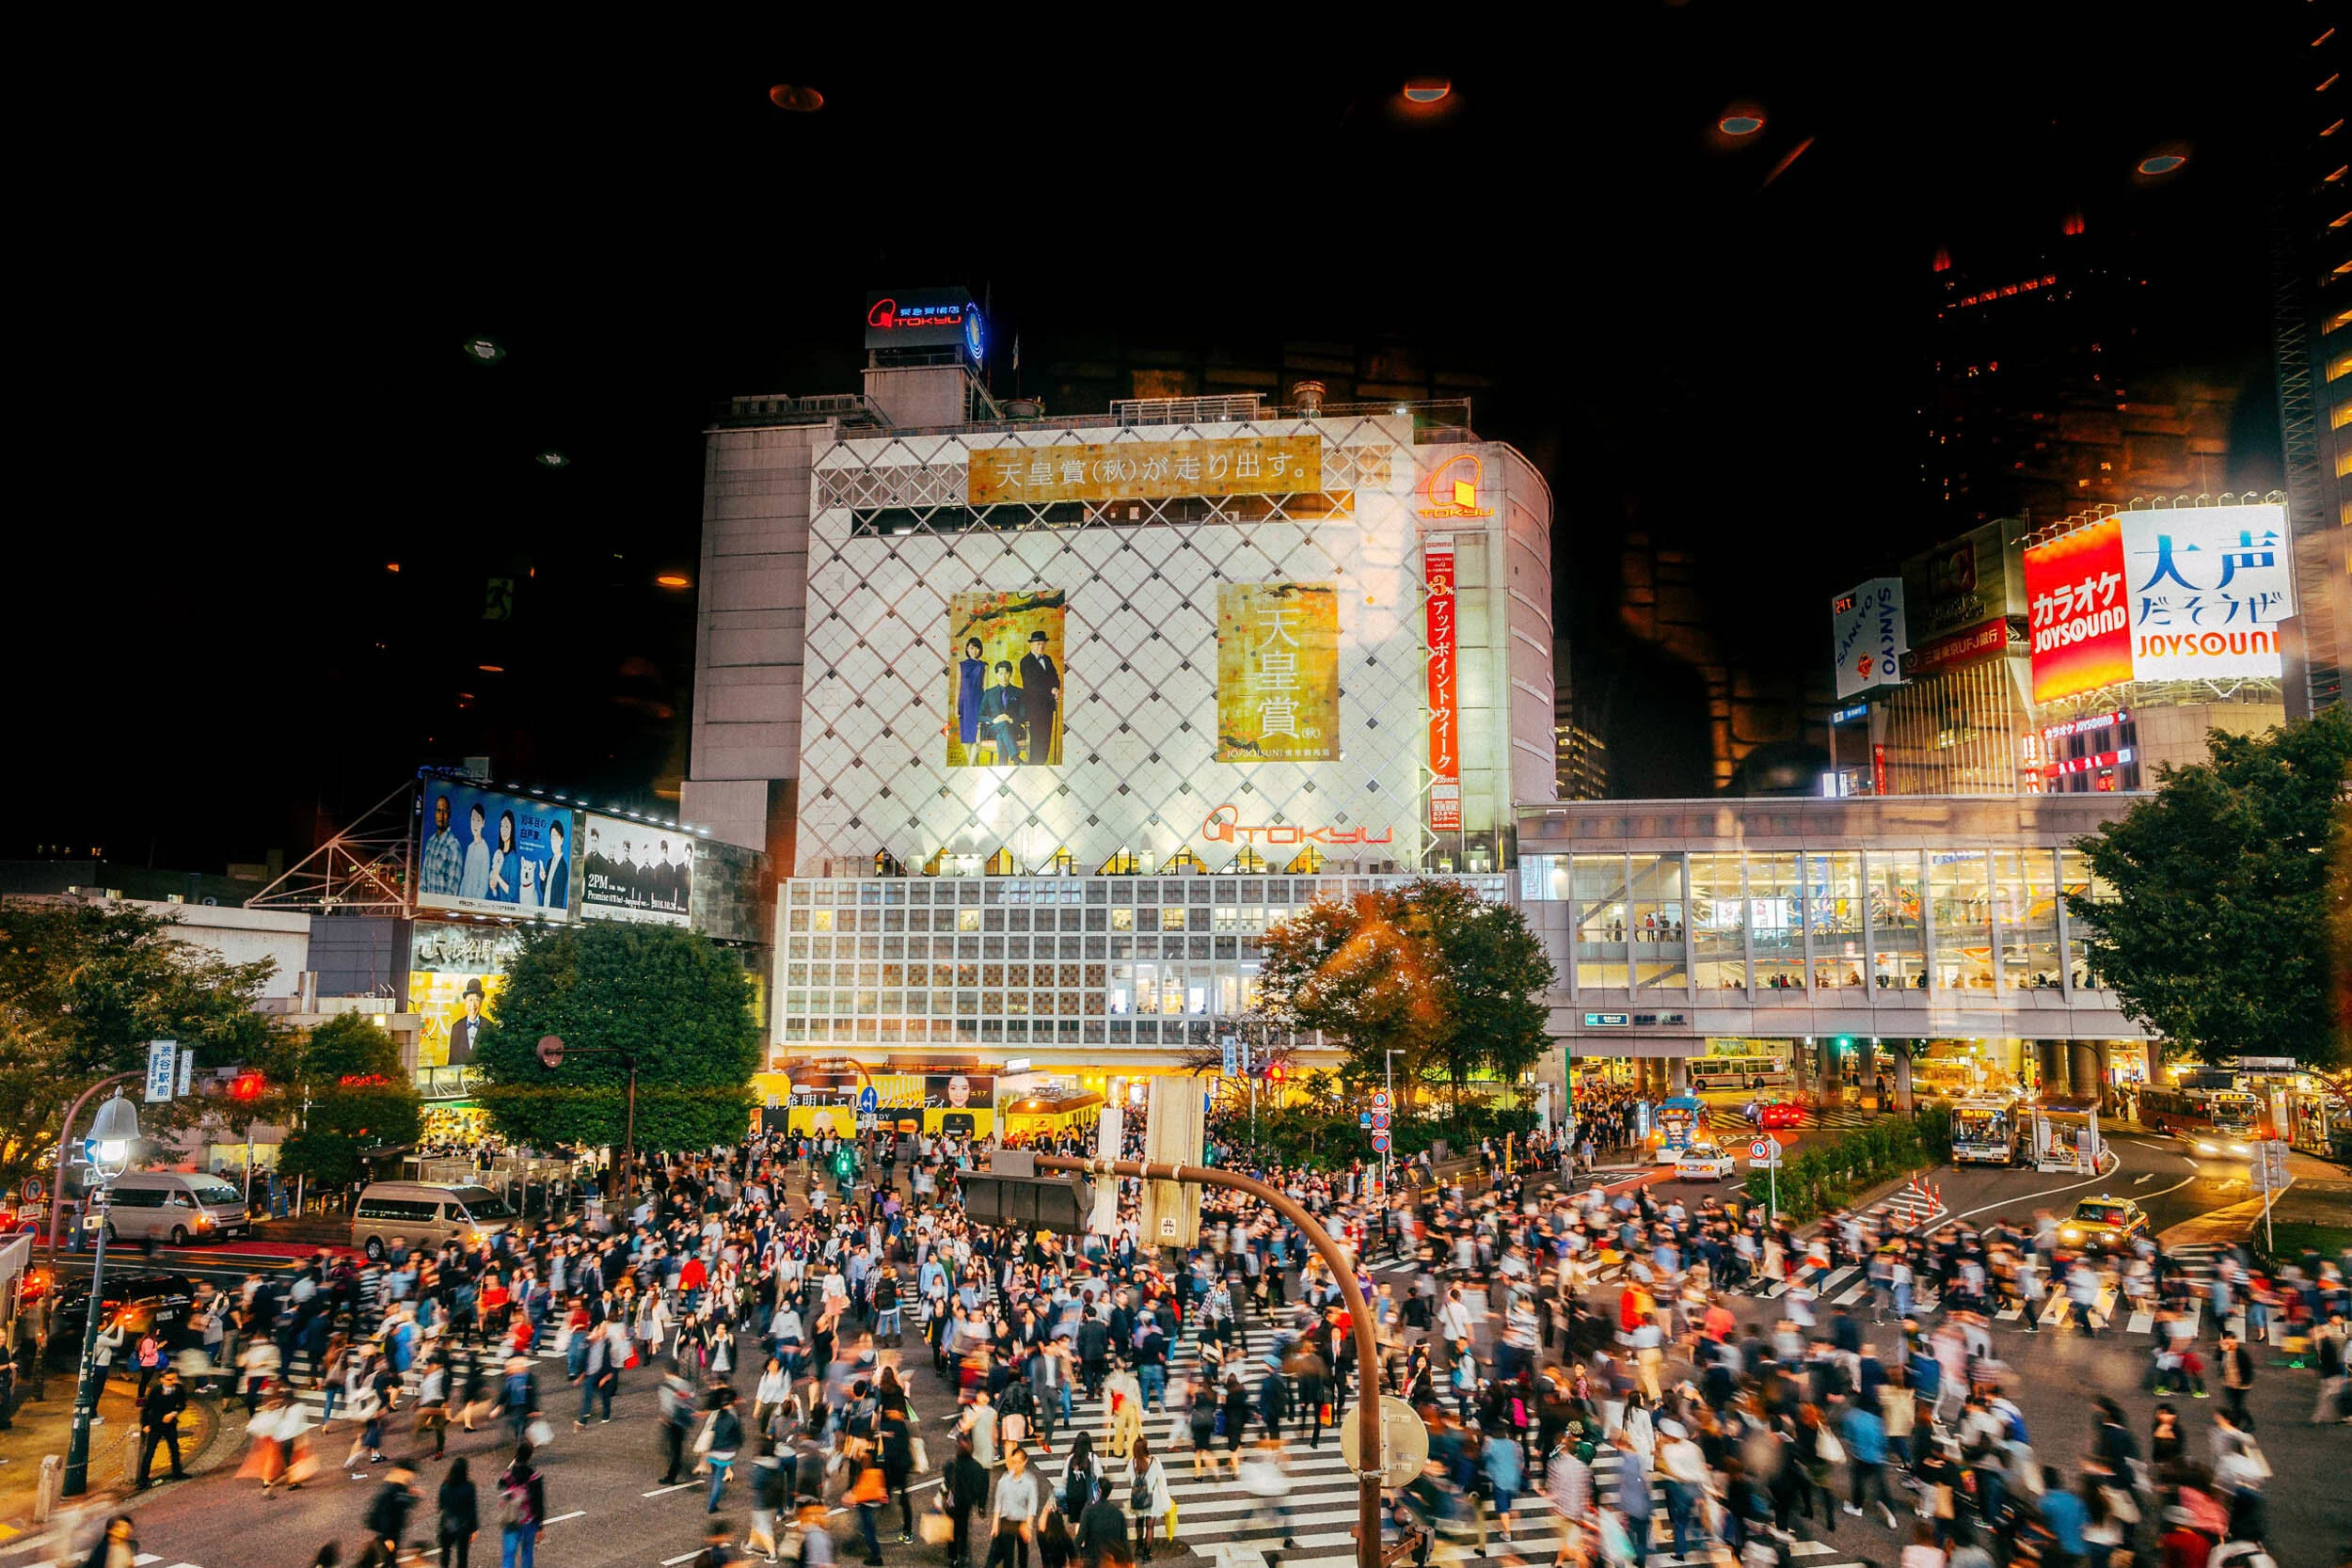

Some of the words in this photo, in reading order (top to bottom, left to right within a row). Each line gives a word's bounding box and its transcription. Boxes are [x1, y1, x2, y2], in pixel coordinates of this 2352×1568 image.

[895, 315, 961, 326] TOKYU
[1418, 506, 1494, 518] TOKYU
[2133, 529, 2280, 594] 大声
[2032, 571, 2122, 628] カラオケ
[2136, 592, 2284, 627] だそうぜ
[1836, 594, 1873, 667] SANKYO
[1878, 587, 1898, 675] SANKYO
[2034, 606, 2126, 654] JOYSOUND
[1256, 609, 1301, 740] 天皇賞
[2044, 723, 2075, 740] カラオケ
[2075, 714, 2115, 733] JOYSOUND
[1235, 825, 1393, 845] TOKYU
[587, 873, 609, 890] 2PM
[157, 1045, 172, 1097] 渋谷駅前
